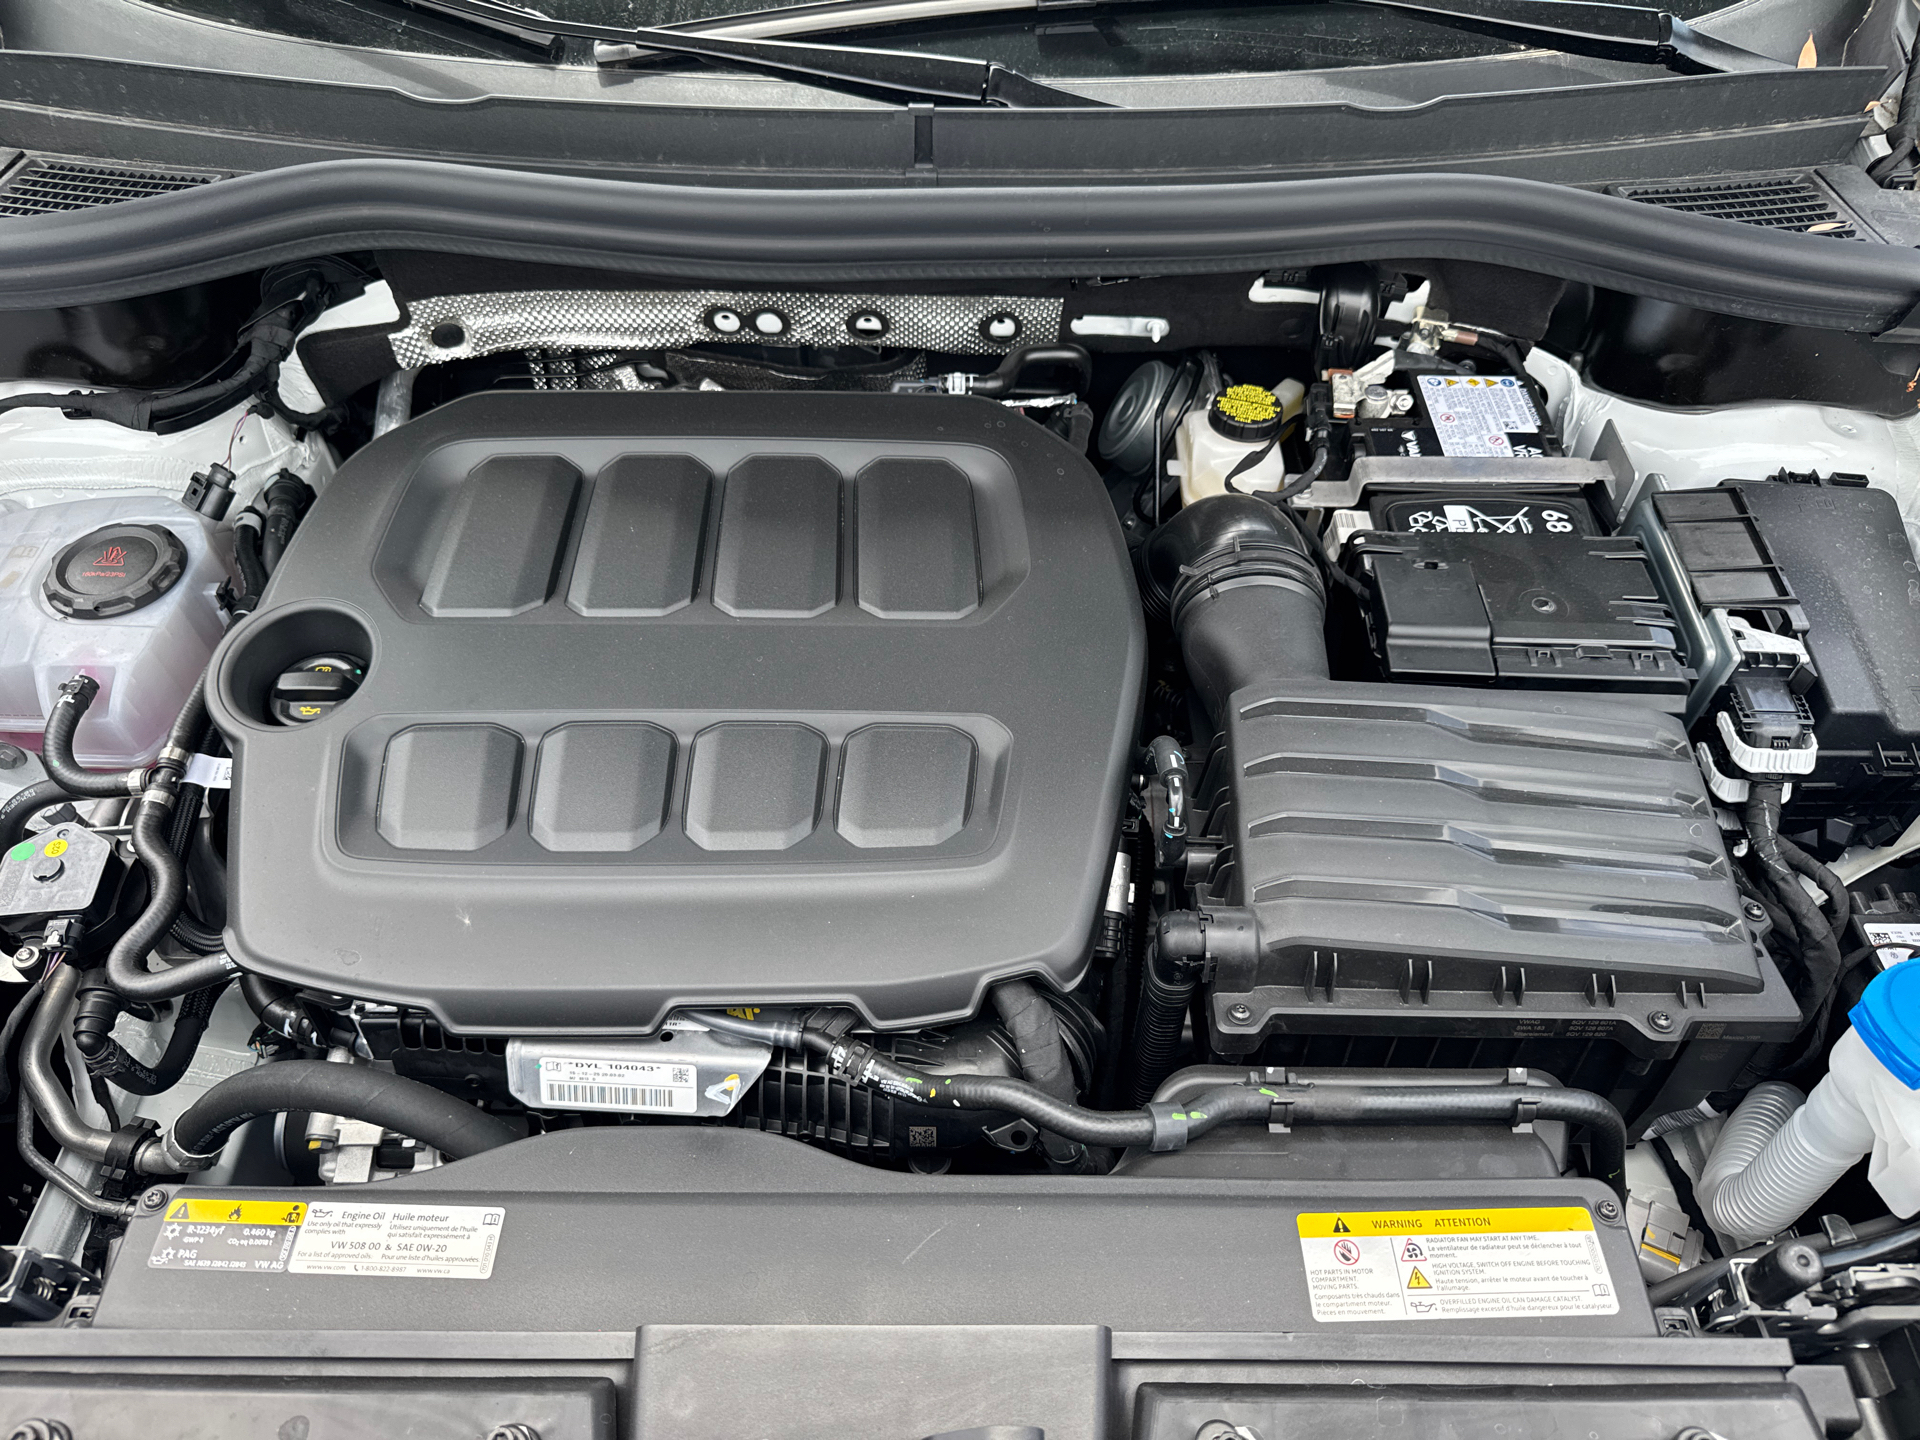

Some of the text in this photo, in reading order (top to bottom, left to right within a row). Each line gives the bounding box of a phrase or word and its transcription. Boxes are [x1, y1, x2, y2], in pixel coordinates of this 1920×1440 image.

[1541, 509, 1573, 533] 68
[342, 1211, 386, 1221] Engine Oil
[392, 1213, 449, 1222] Huile moteur
[1371, 1217, 1491, 1229] WARNING ATTENTION
[186, 1225, 277, 1238] R-1234yf 0.460 kg
[331, 1241, 348, 1249] VW
[349, 1242, 366, 1250] 508
[368, 1242, 381, 1250] 00
[397, 1243, 415, 1252] SAE
[416, 1244, 448, 1252] 0W-20
[177, 1250, 198, 1258] PAG
